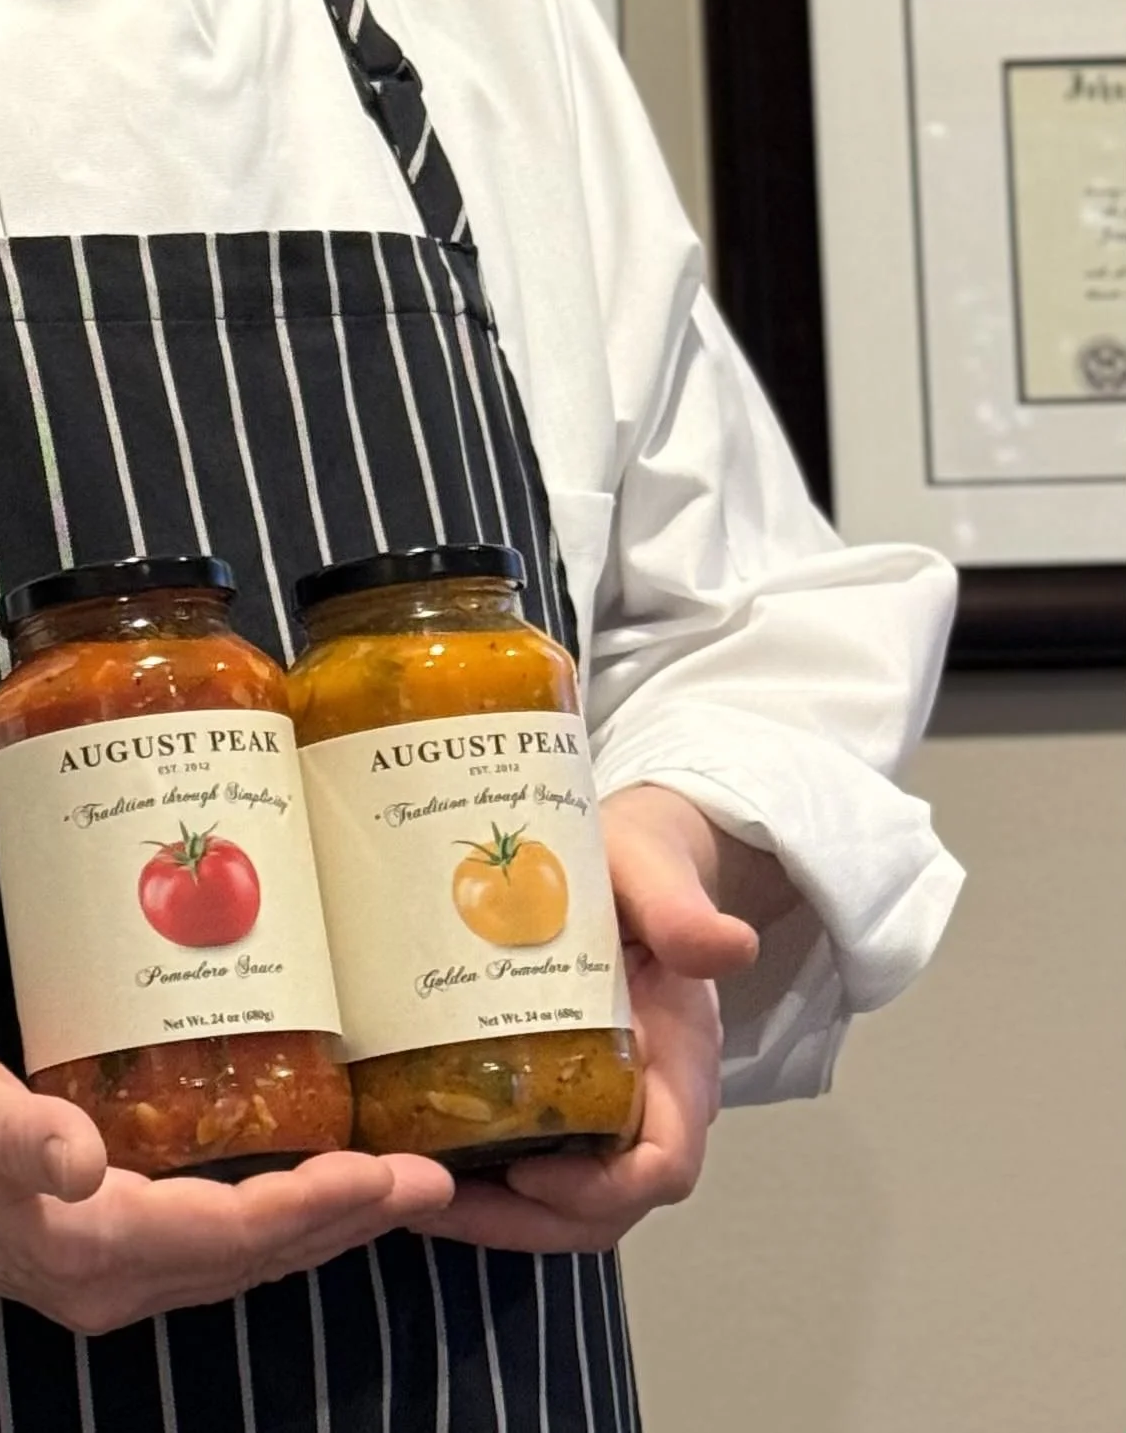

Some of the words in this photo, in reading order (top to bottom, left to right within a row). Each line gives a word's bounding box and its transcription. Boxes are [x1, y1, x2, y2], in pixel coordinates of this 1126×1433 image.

[59, 731, 197, 774] AUGUST
[207, 729, 280, 754] PEAK
[370, 733, 507, 772] AUGUST
[517, 731, 579, 756] PEAK
[157, 764, 179, 776] EST.
[184, 761, 210, 773] 2012
[161, 783, 220, 809] through
[473, 783, 529, 810] through
[134, 959, 230, 988] Pomodoro
[234, 953, 284, 980] Sauce
[414, 965, 480, 1000] Golden
[485, 956, 572, 982] Pomodoro
[162, 1017, 184, 1032] Net
[186, 1014, 209, 1028] Wt.
[210, 1012, 224, 1025] 24
[226, 1014, 240, 1023] oz
[241, 1008, 275, 1024] (680g)
[477, 1016, 499, 1029] Net
[501, 1012, 524, 1025] Wt.
[524, 1010, 538, 1023] 24
